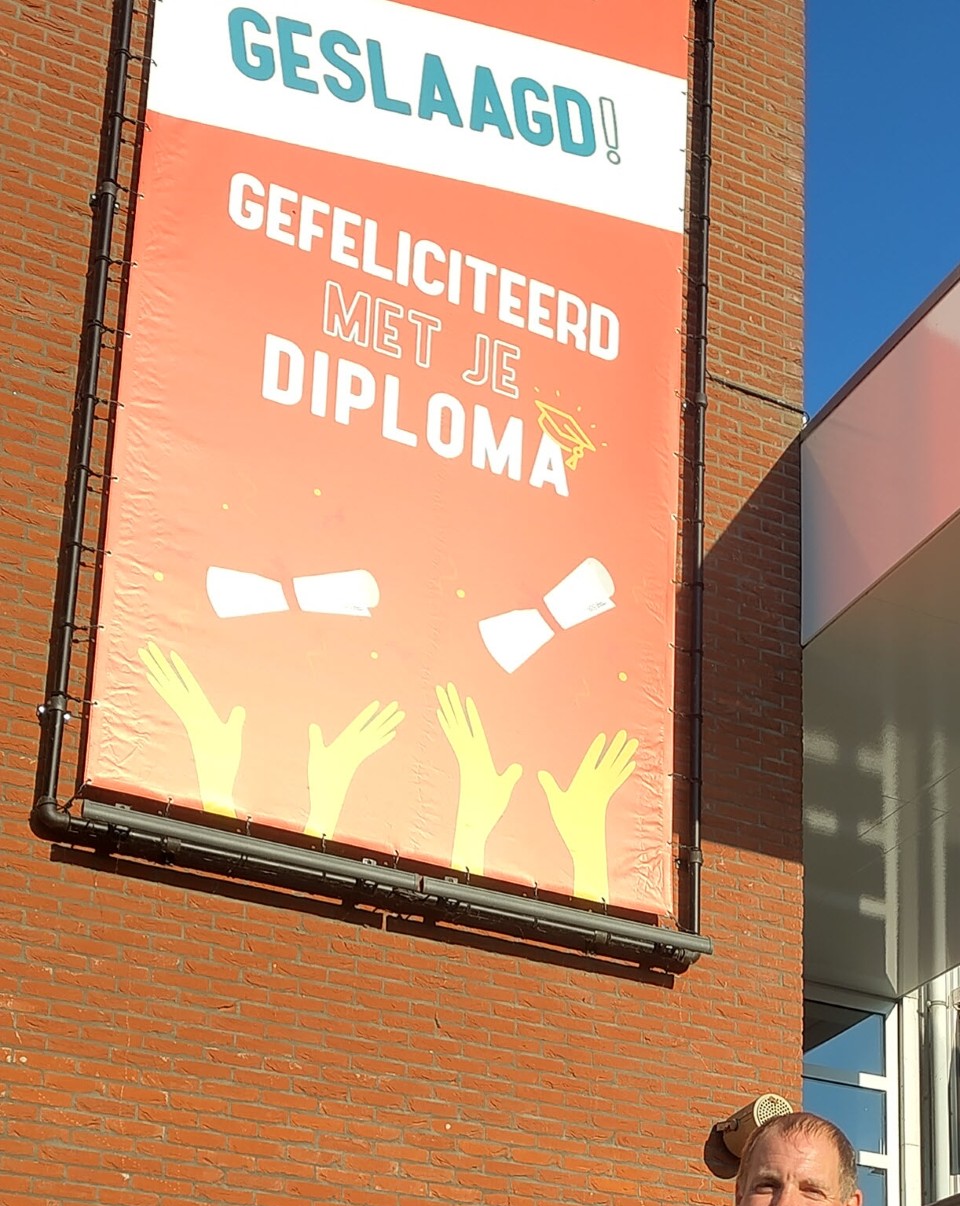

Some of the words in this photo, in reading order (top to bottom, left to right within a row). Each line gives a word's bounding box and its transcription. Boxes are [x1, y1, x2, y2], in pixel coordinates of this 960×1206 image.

[227, 6, 622, 166] GESLAAGD!
[228, 172, 621, 362] GEFELICITEERD
[322, 280, 442, 369] MET
[461, 333, 521, 400] JE
[261, 333, 570, 498] DIPLOMA
